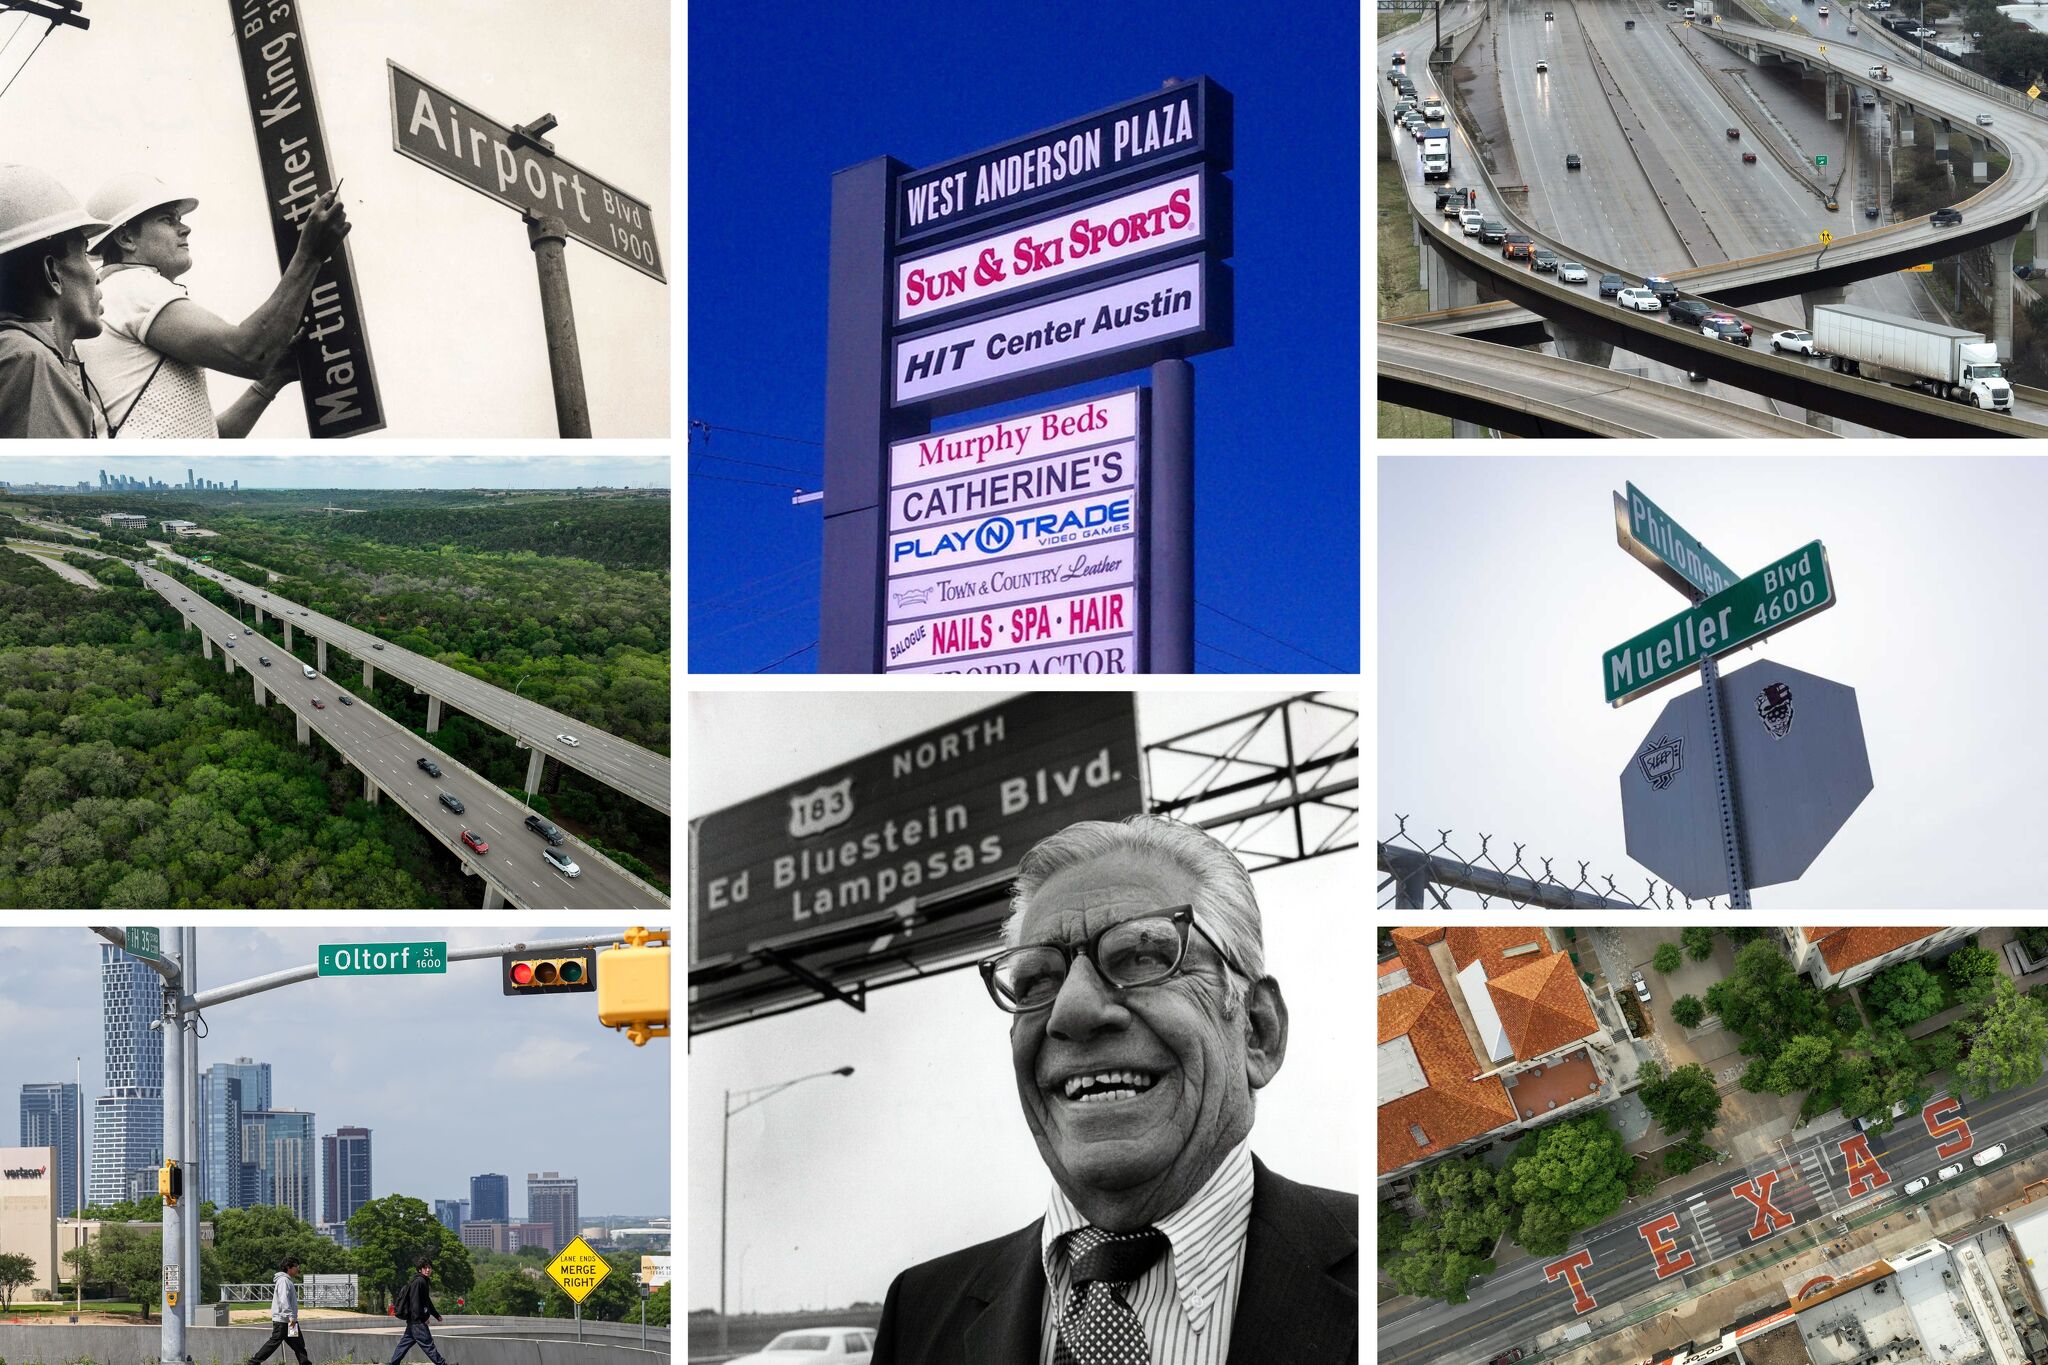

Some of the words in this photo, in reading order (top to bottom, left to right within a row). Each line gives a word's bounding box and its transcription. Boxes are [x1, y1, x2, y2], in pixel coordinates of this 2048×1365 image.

[260, 32, 301, 129] King
[409, 89, 592, 223] Airport
[601, 188, 644, 229] Blvd
[908, 172, 967, 227] WEST
[975, 128, 1101, 206] ANDERSON
[1114, 99, 1193, 162] PLAZA
[610, 223, 655, 266] 1900
[906, 267, 968, 307] SUN
[974, 247, 1006, 287] &
[1013, 236, 1063, 275] SKI
[1069, 188, 1192, 260] SPORTS
[305, 280, 363, 427] Martin
[904, 339, 976, 383] HIT
[986, 315, 1086, 361] Center
[1092, 287, 1192, 335] Austin
[918, 424, 1032, 468] Murphy
[1041, 404, 1109, 441] Beds
[903, 450, 1123, 522] CATHERINE'S
[894, 528, 976, 562] PLAY
[1015, 499, 1130, 540] TRADE
[1039, 532, 1078, 546] VIDEO
[1083, 523, 1130, 538] GAMES
[937, 579, 977, 602] TOWN
[978, 582, 989, 594] &
[990, 565, 1062, 593] COUNTRY
[1060, 554, 1123, 582] Leather
[1753, 580, 1815, 625] 4600
[890, 625, 927, 660] BALOGUE
[932, 614, 993, 656] NAILS
[1011, 605, 1051, 644] SPA
[1069, 593, 1124, 635] HAIR
[1611, 605, 1732, 692] Mueller
[1763, 551, 1811, 595] Blvd
[892, 717, 1006, 778] NORTH
[708, 870, 749, 911] Ed
[774, 802, 968, 888] Bluestein
[1001, 750, 1122, 816] Blvd.
[797, 794, 846, 825] 183
[792, 834, 1002, 921] Lampasas
[324, 956, 330, 964] E
[335, 947, 410, 970] Oltorf
[423, 948, 434, 956] St
[416, 959, 441, 968] 1600
[1544, 1096, 1974, 1316] TEXAS
[560, 1265, 596, 1275] MERGE
[563, 1278, 595, 1288] RIGHT
